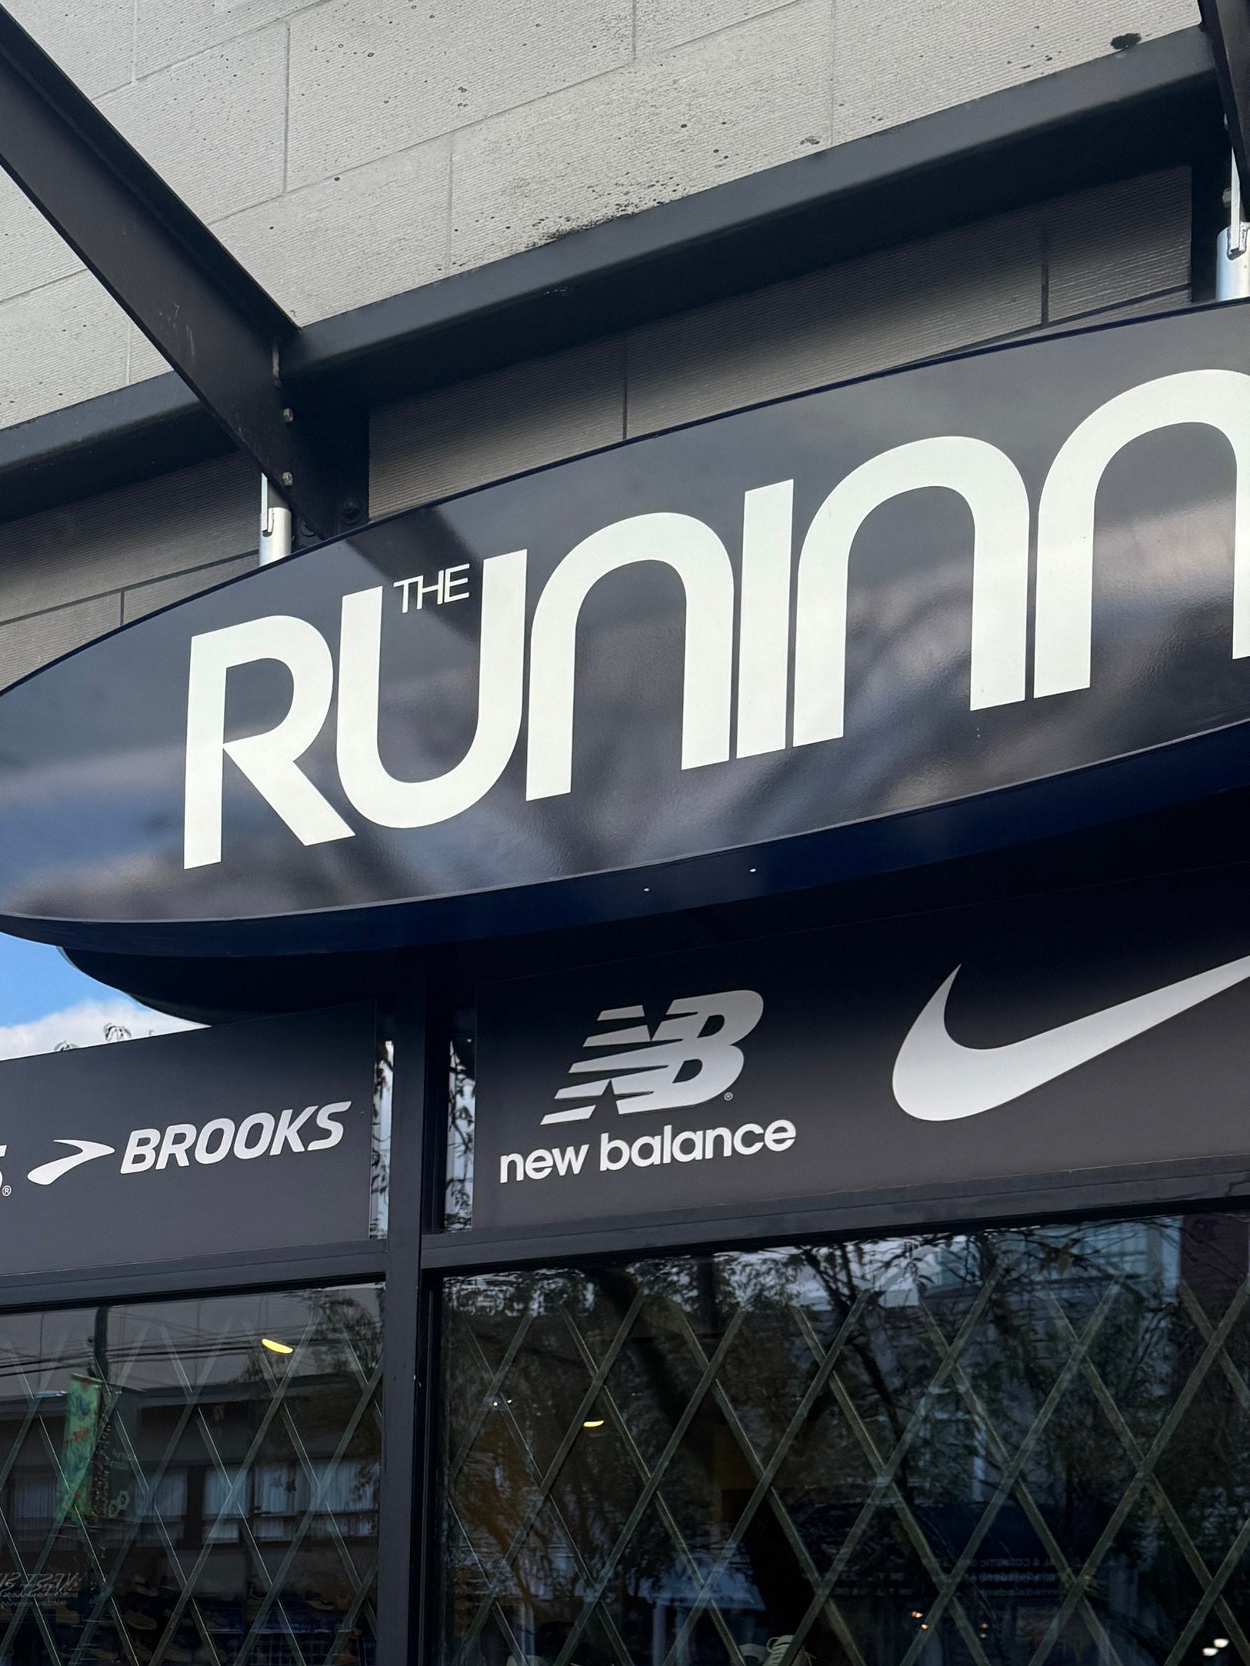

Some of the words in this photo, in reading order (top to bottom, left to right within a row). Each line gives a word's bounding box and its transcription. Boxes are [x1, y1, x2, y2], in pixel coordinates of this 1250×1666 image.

[393, 562, 470, 615] THE
[119, 1100, 352, 1175] BROOKS
[499, 1141, 590, 1184] new
[599, 1118, 797, 1172] balance
